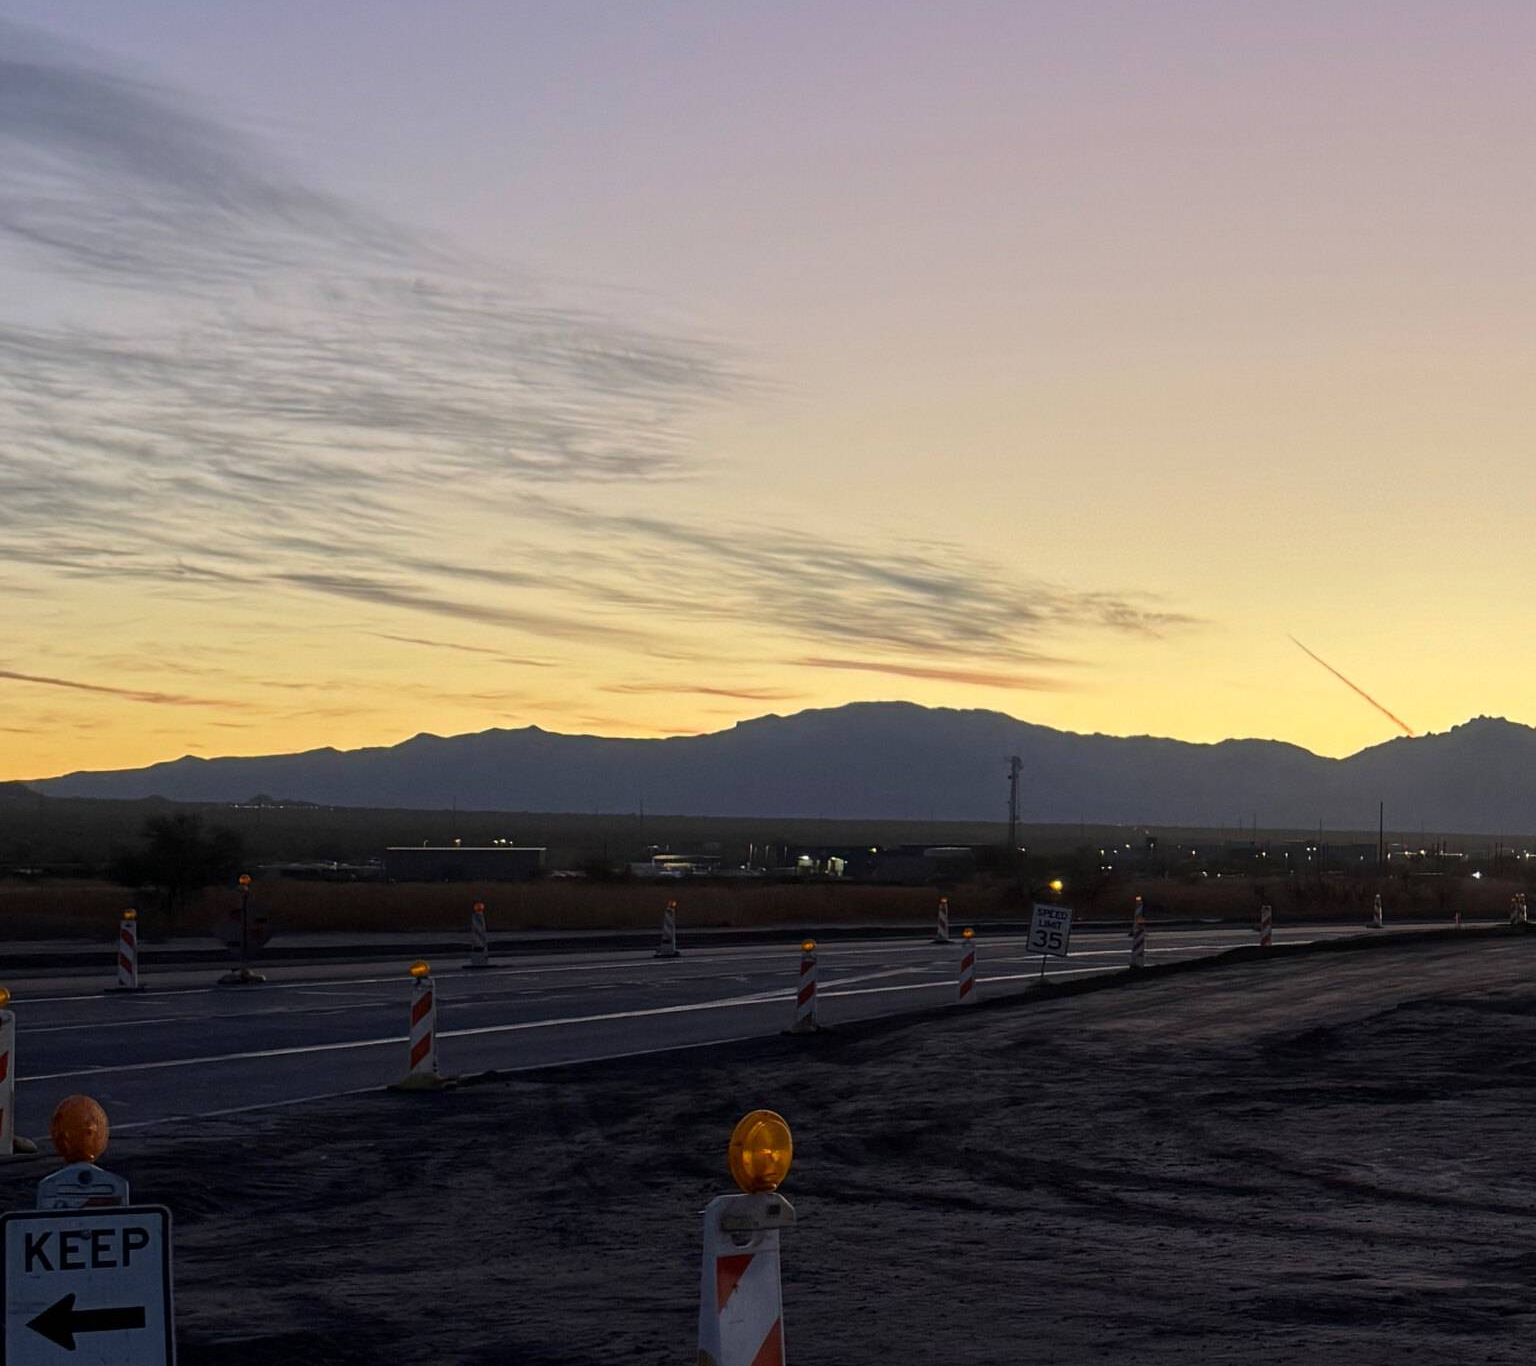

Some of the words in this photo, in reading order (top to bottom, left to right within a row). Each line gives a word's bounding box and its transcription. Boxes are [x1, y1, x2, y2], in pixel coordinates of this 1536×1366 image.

[1037, 908, 1068, 920] SPEED
[1039, 920, 1062, 930] LIMIT
[1033, 930, 1062, 950] 35
[25, 1227, 149, 1272] KEEP
